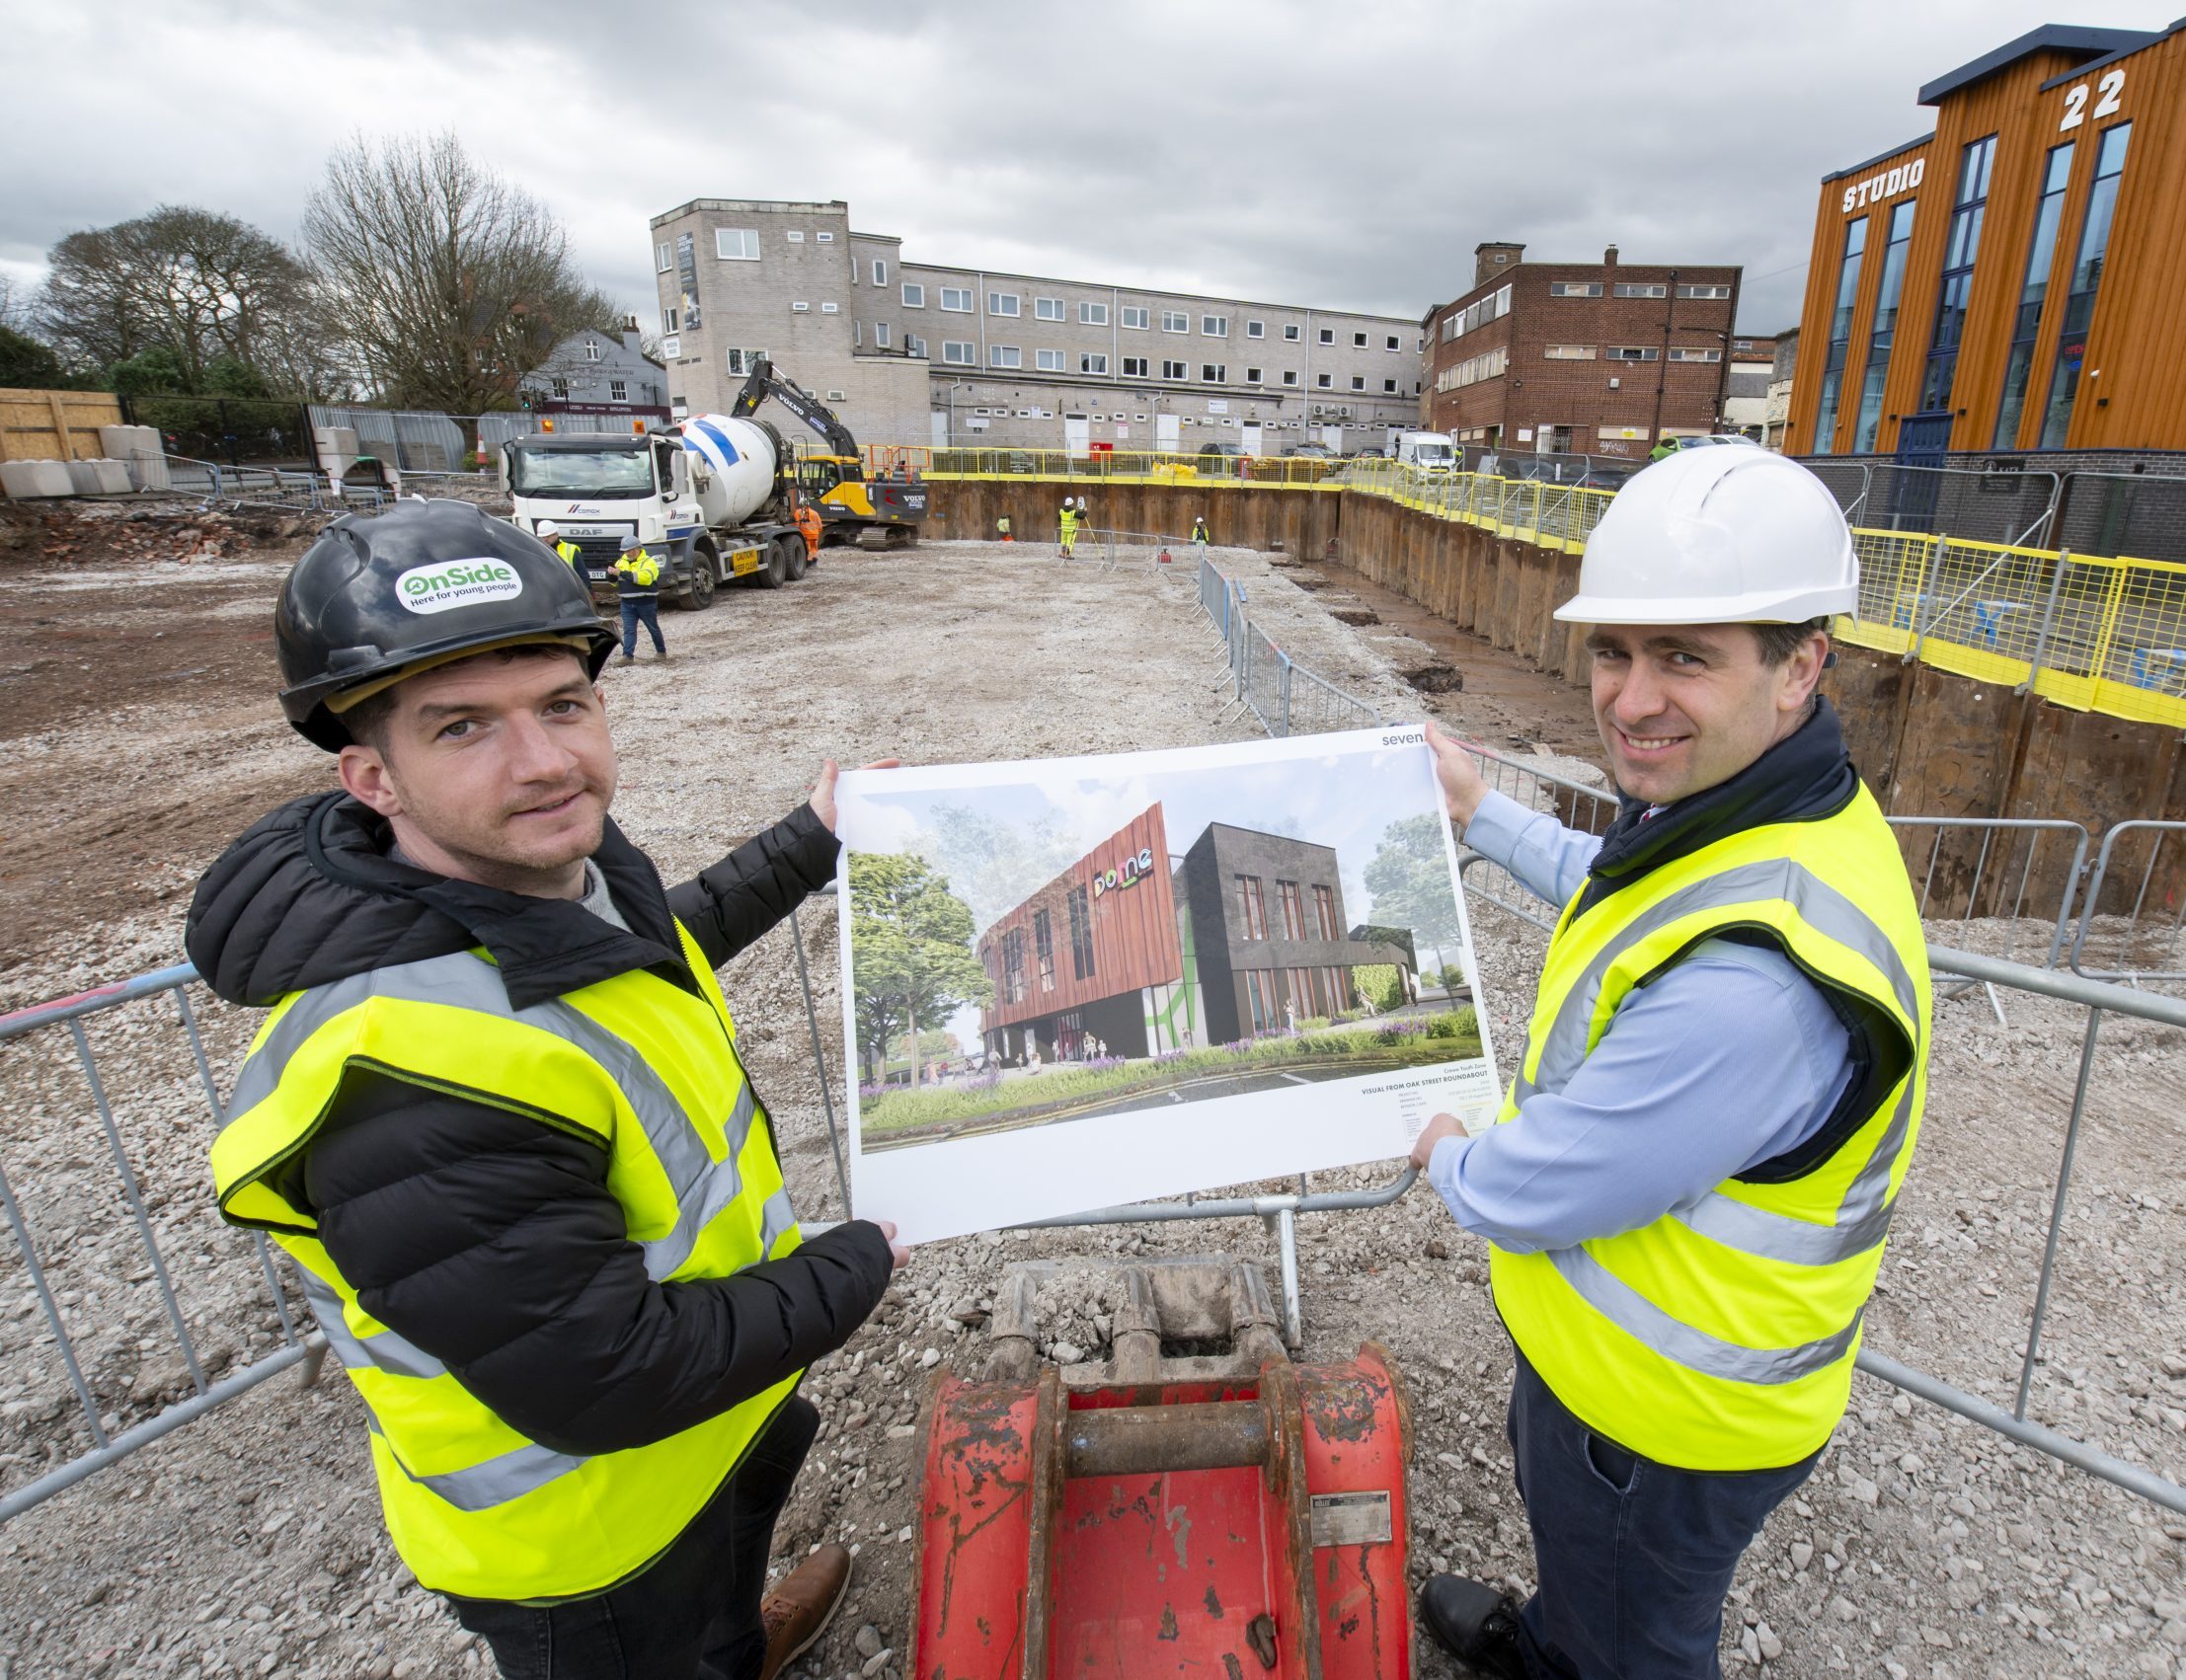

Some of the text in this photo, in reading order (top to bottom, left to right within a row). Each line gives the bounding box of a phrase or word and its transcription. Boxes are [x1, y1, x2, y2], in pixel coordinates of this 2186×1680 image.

[1842, 158, 1925, 213] STUDIO
[779, 393, 804, 415] VOLVO
[404, 564, 512, 595] OnSide
[410, 581, 517, 607] Here for young people
[1382, 732, 1424, 746] seven
[1362, 1070, 1489, 1096] VISUAL FROM OAK STREET ROUNDABOUT
